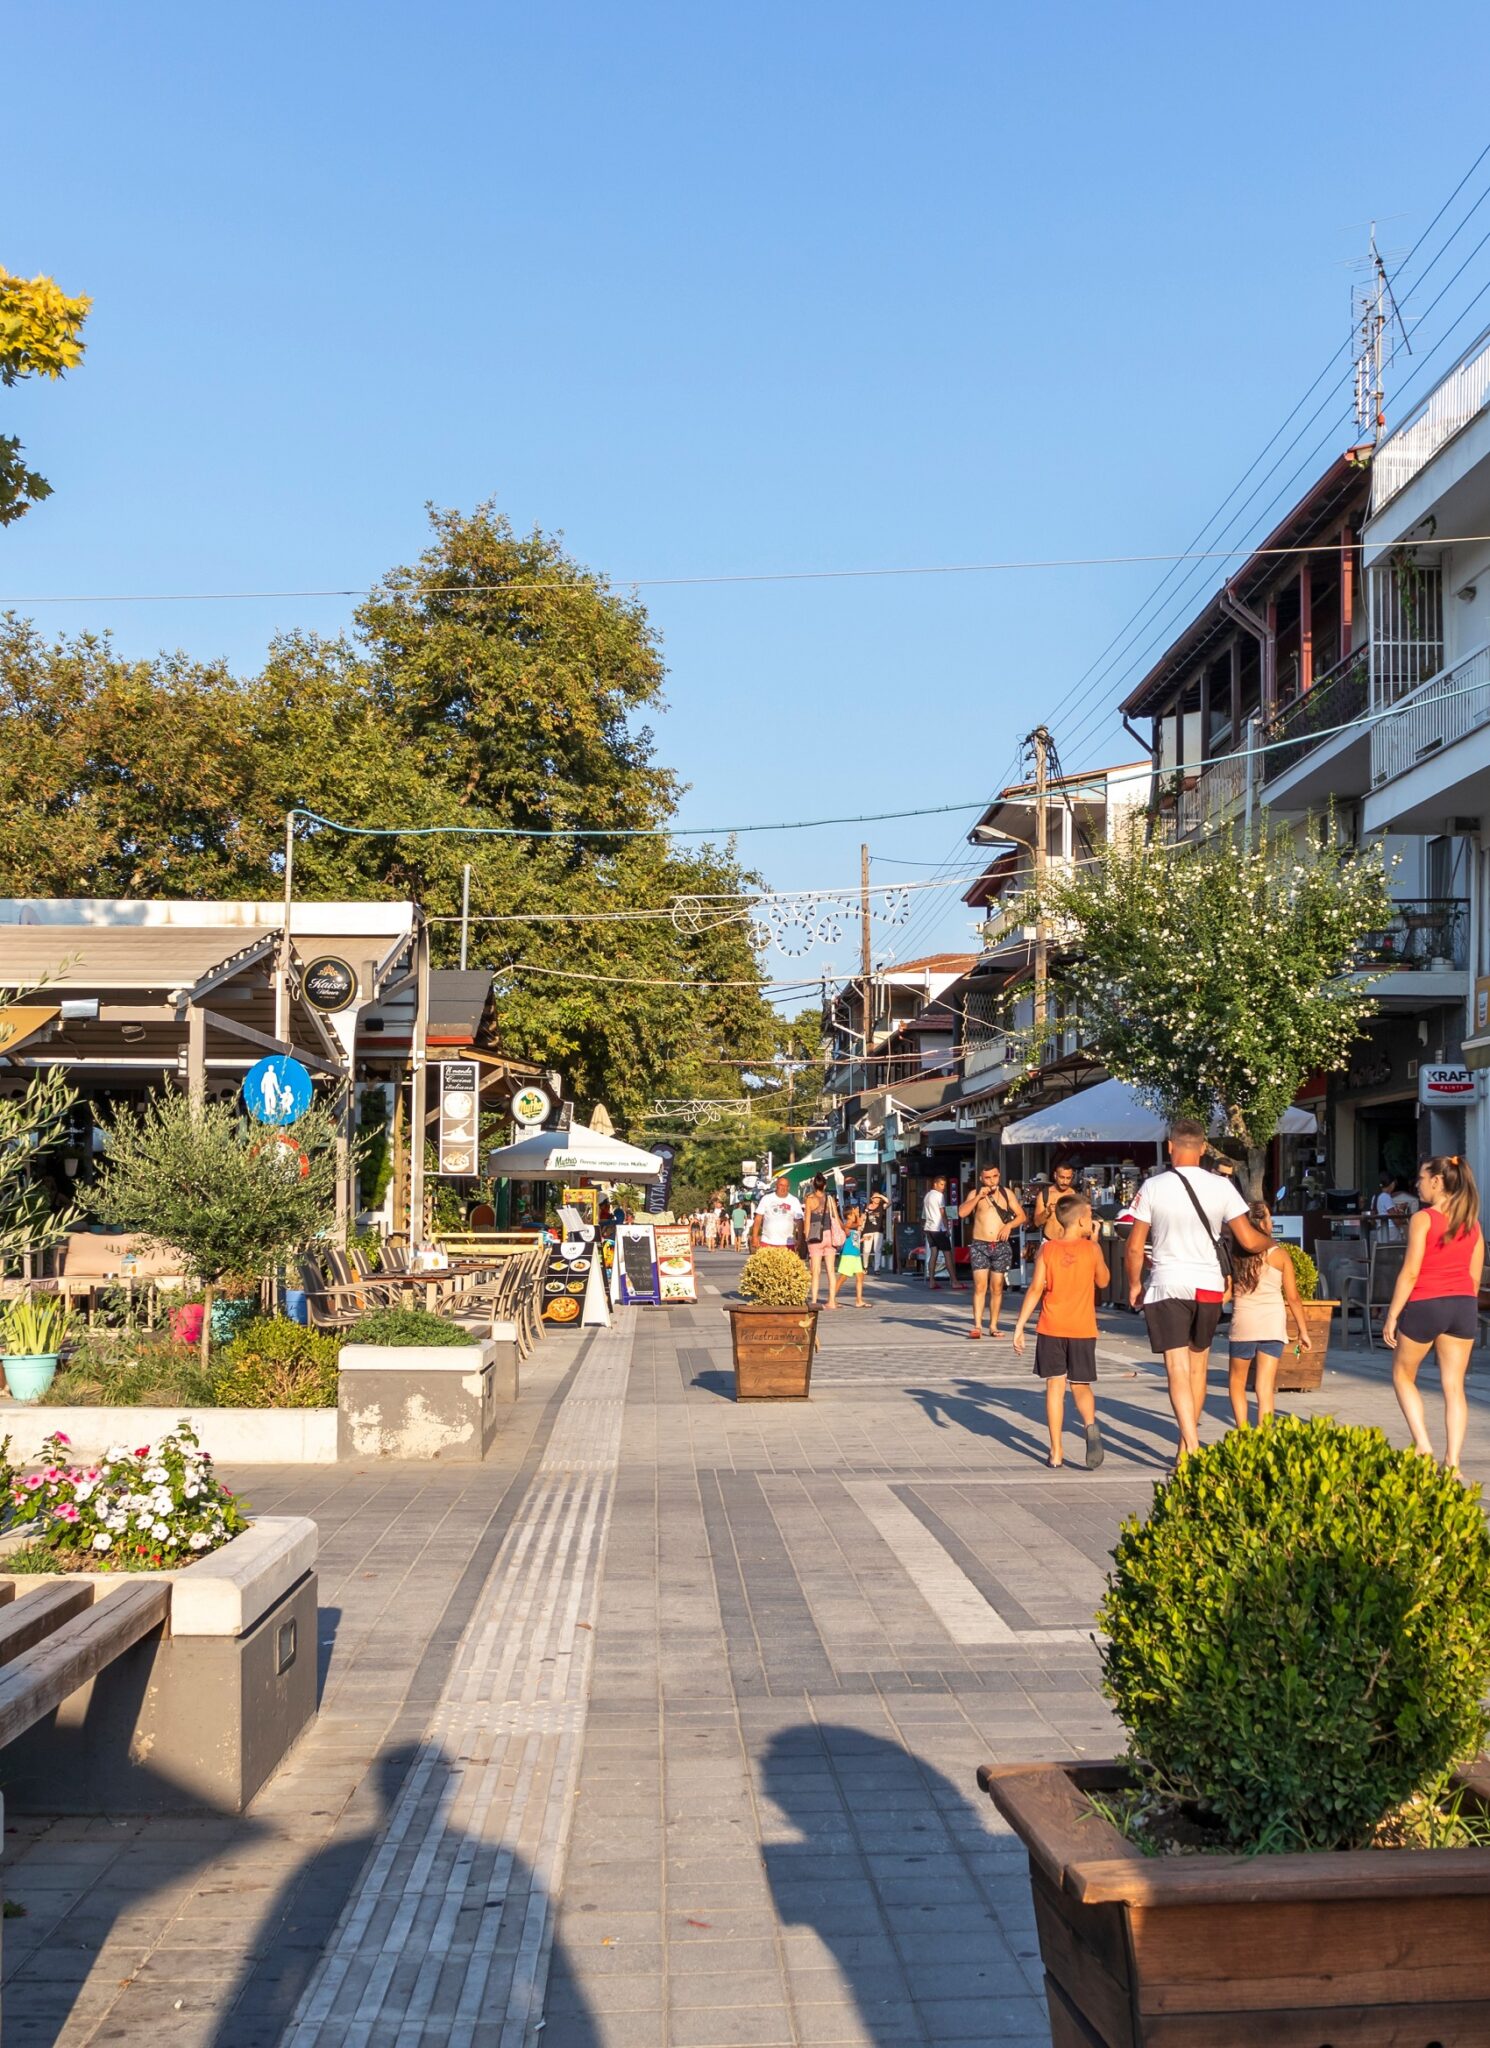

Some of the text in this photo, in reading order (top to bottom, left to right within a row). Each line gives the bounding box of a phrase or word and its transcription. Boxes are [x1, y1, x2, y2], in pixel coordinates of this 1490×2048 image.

[308, 978, 348, 990] Kaiser
[1428, 1071, 1474, 1082] KRAFT
[554, 1156, 577, 1168] Mythos
